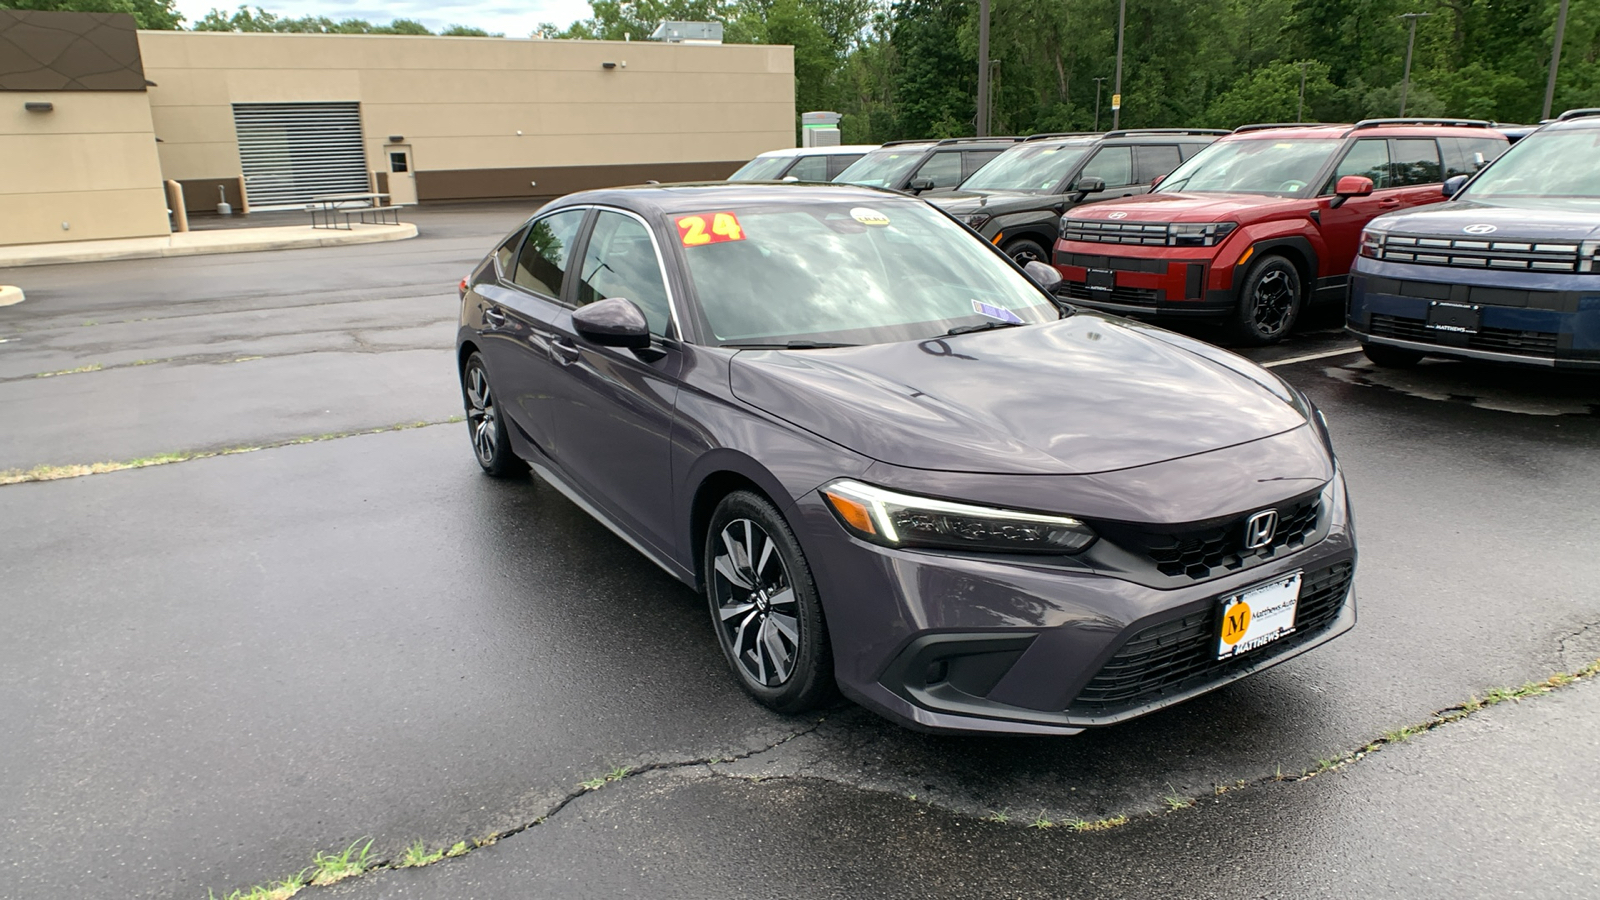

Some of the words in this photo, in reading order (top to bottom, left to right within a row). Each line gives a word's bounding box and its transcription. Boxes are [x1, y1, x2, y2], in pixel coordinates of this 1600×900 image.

[678, 213, 741, 245] 24
[1251, 604, 1281, 620] Matthews
[1282, 598, 1297, 608] Auto
[1226, 610, 1247, 637] M
[1234, 629, 1280, 656] MATTHEWS
